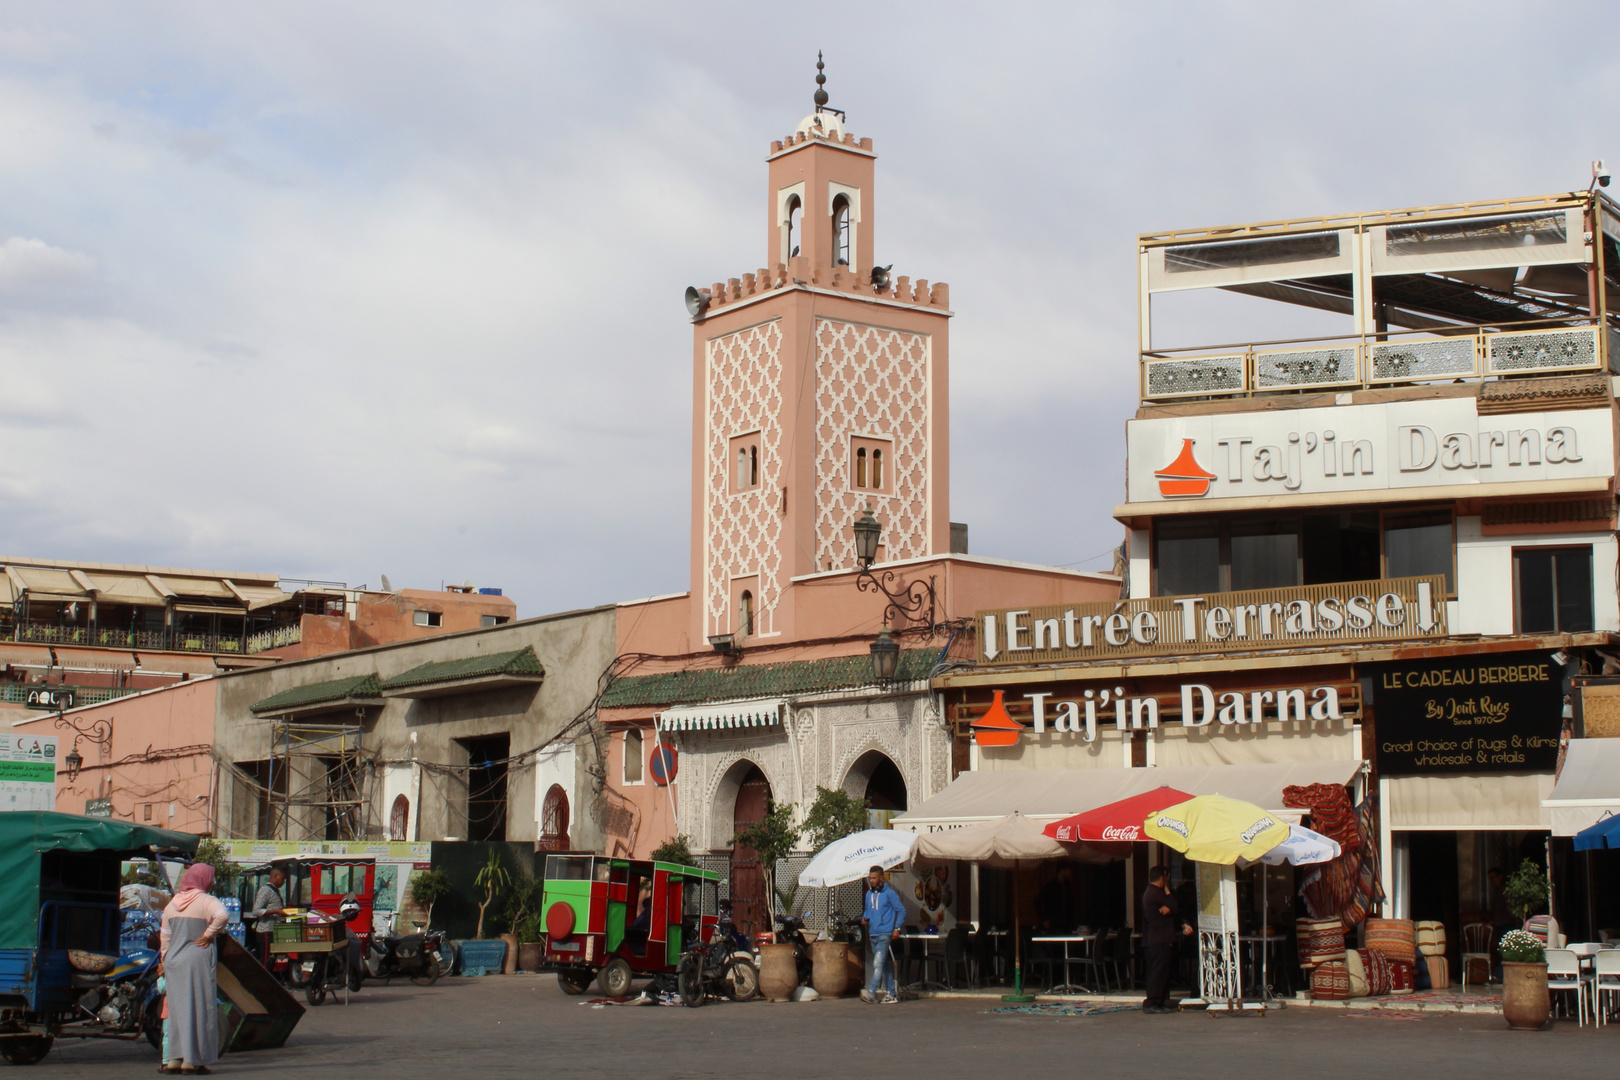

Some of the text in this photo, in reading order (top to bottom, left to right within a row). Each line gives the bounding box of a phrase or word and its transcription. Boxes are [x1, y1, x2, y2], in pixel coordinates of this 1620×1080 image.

[1399, 424, 1583, 474] Darna
[1006, 592, 1405, 651] Entrée Terrasse
[1383, 664, 1550, 689] LE CADEAU BERBERE
[1179, 683, 1344, 728] Darna
[1425, 699, 1444, 720] By
[1480, 695, 1510, 723] Rugs
[1453, 716, 1493, 726] Since 1970
[1382, 740, 1414, 753] Great
[1416, 738, 1458, 752] Choice
[1461, 737, 1475, 750] of
[1477, 737, 1507, 752] Rugs
[1511, 734, 1523, 748] &
[1414, 750, 1526, 767] wholesale & retails
[1102, 825, 1141, 840] Coca-Cola
[1240, 816, 1275, 845] ORANGINA
